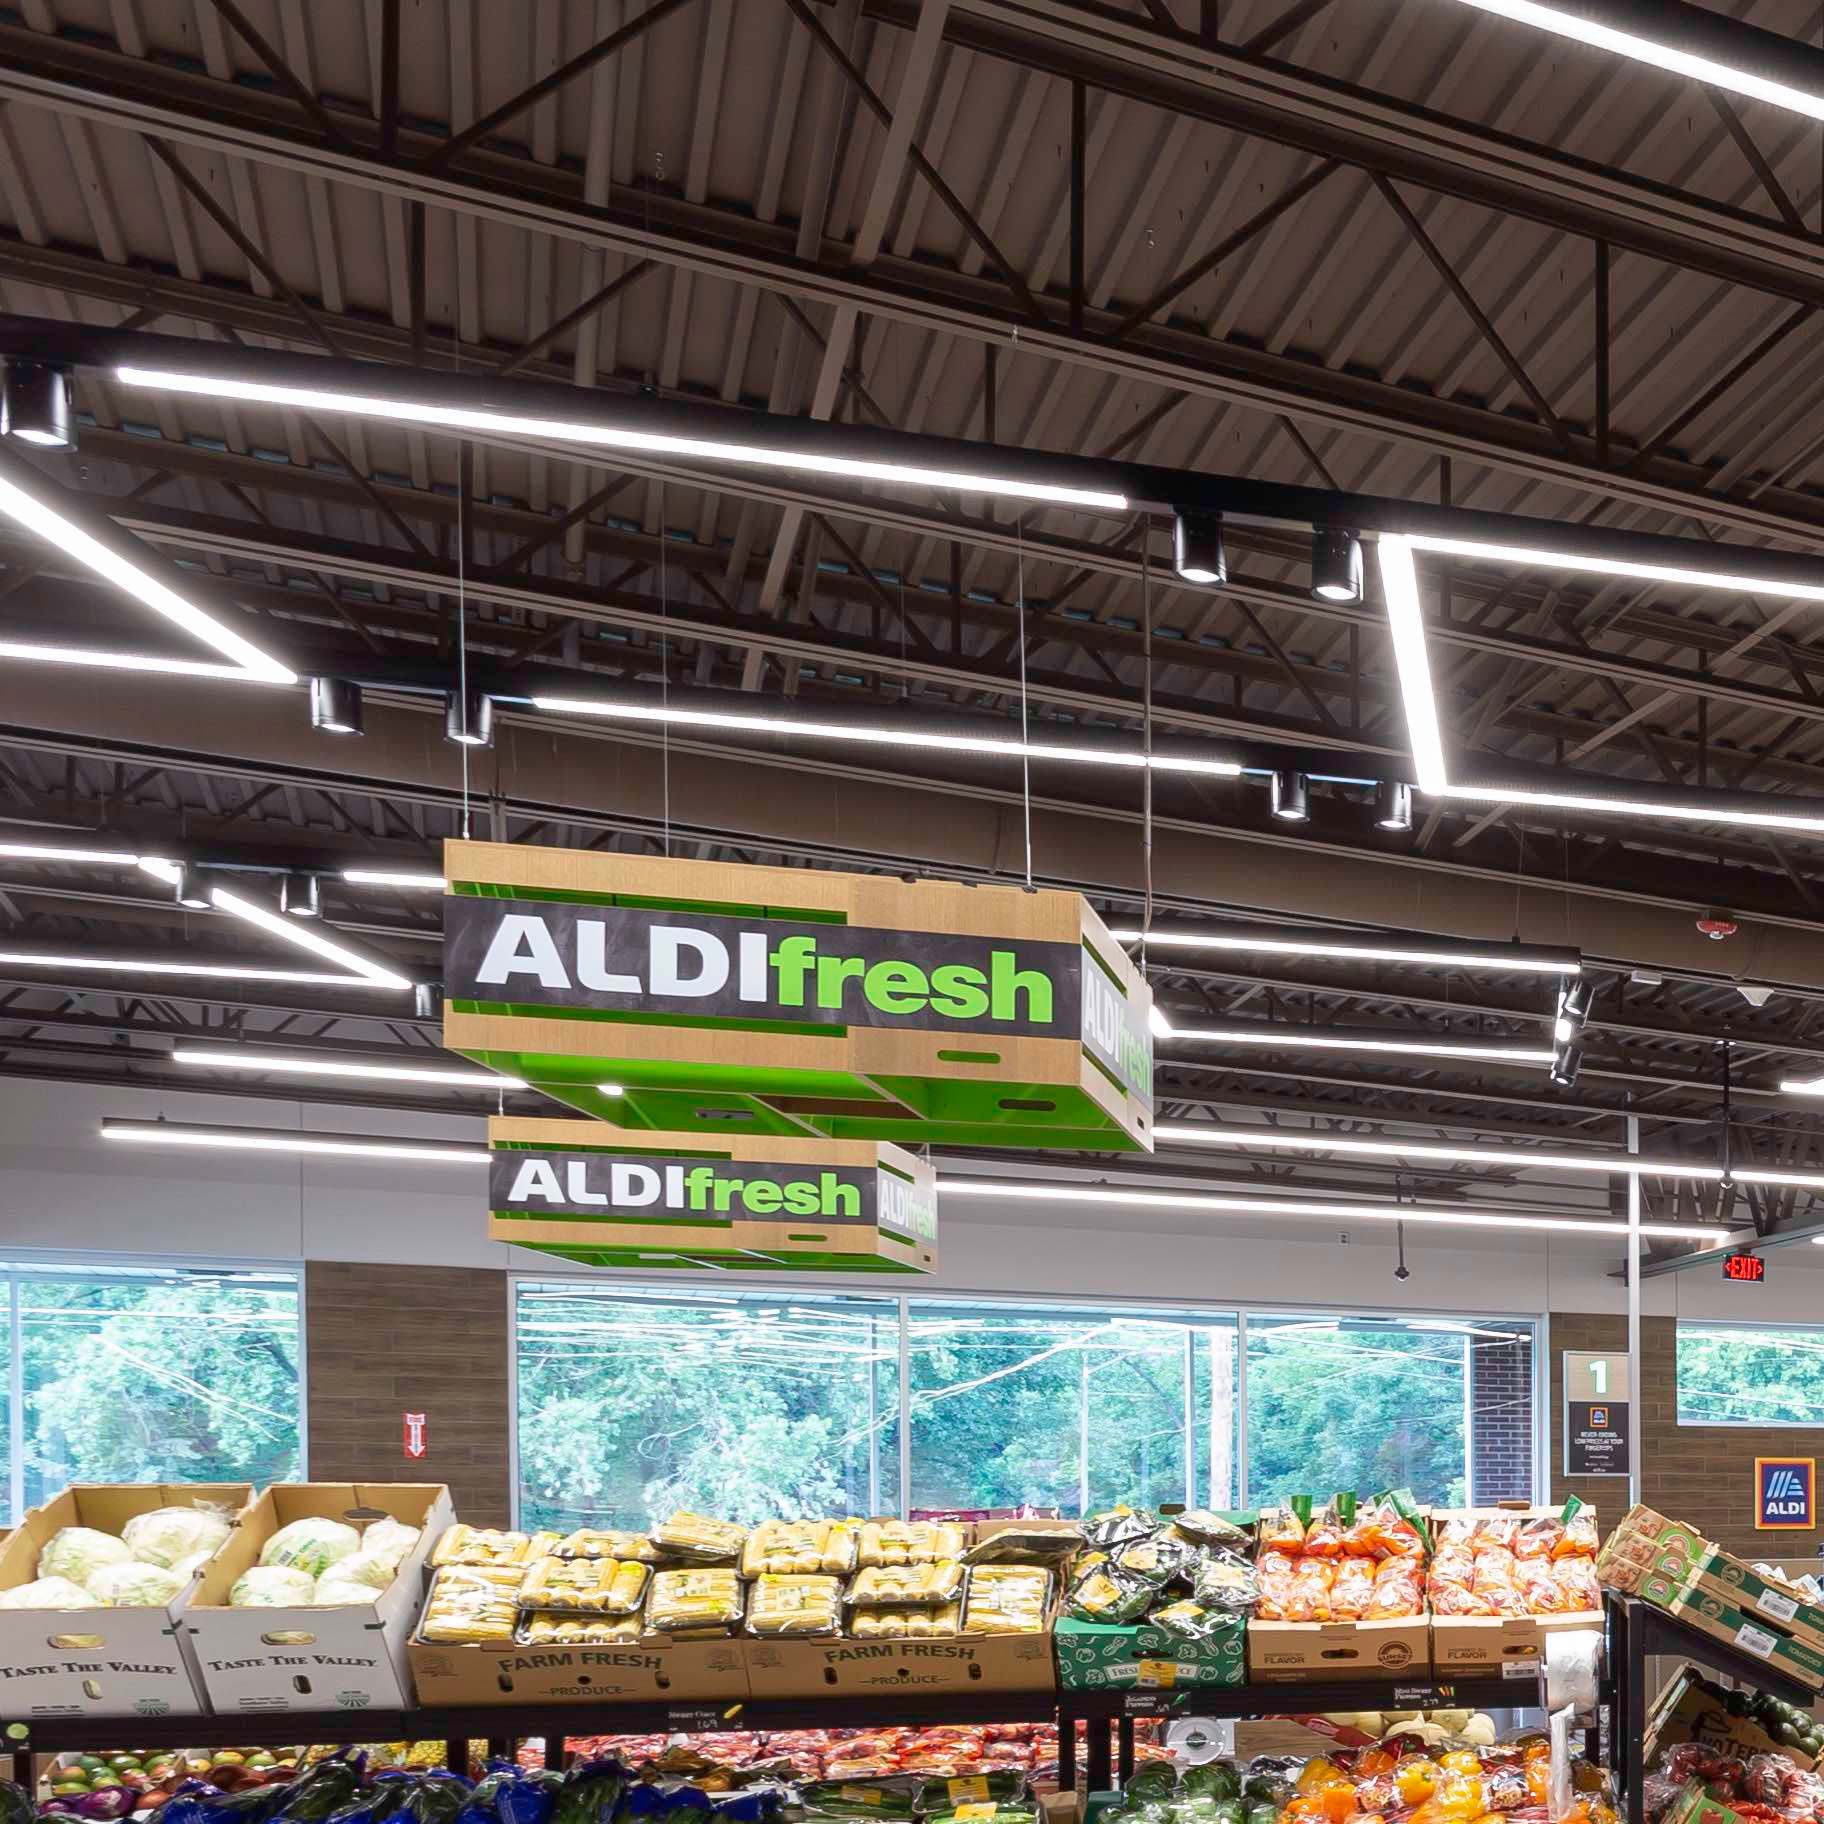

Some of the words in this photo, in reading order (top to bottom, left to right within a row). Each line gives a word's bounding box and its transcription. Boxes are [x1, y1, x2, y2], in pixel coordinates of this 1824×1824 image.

[476, 914, 1053, 1023] ALDIfresh
[507, 1158, 860, 1216] ALDIfresh
[1730, 1256, 1759, 1280] EXIT
[1589, 1360, 1607, 1394] 1
[1766, 1502, 1805, 1515] ALDI
[206, 1657, 265, 1671] TASTE
[268, 1655, 309, 1666] THE
[312, 1655, 380, 1667] VALLEY
[498, 1653, 573, 1673] FARM
[581, 1652, 662, 1670] FRESH
[823, 1645, 894, 1663] FARM
[901, 1644, 977, 1661] FRESH
[1, 1664, 58, 1678] TASTE
[62, 1661, 103, 1673] THE
[106, 1661, 178, 1675] VALLEY
[871, 1674, 939, 1685] PRODUCE
[550, 1685, 623, 1696] PRODUCE
